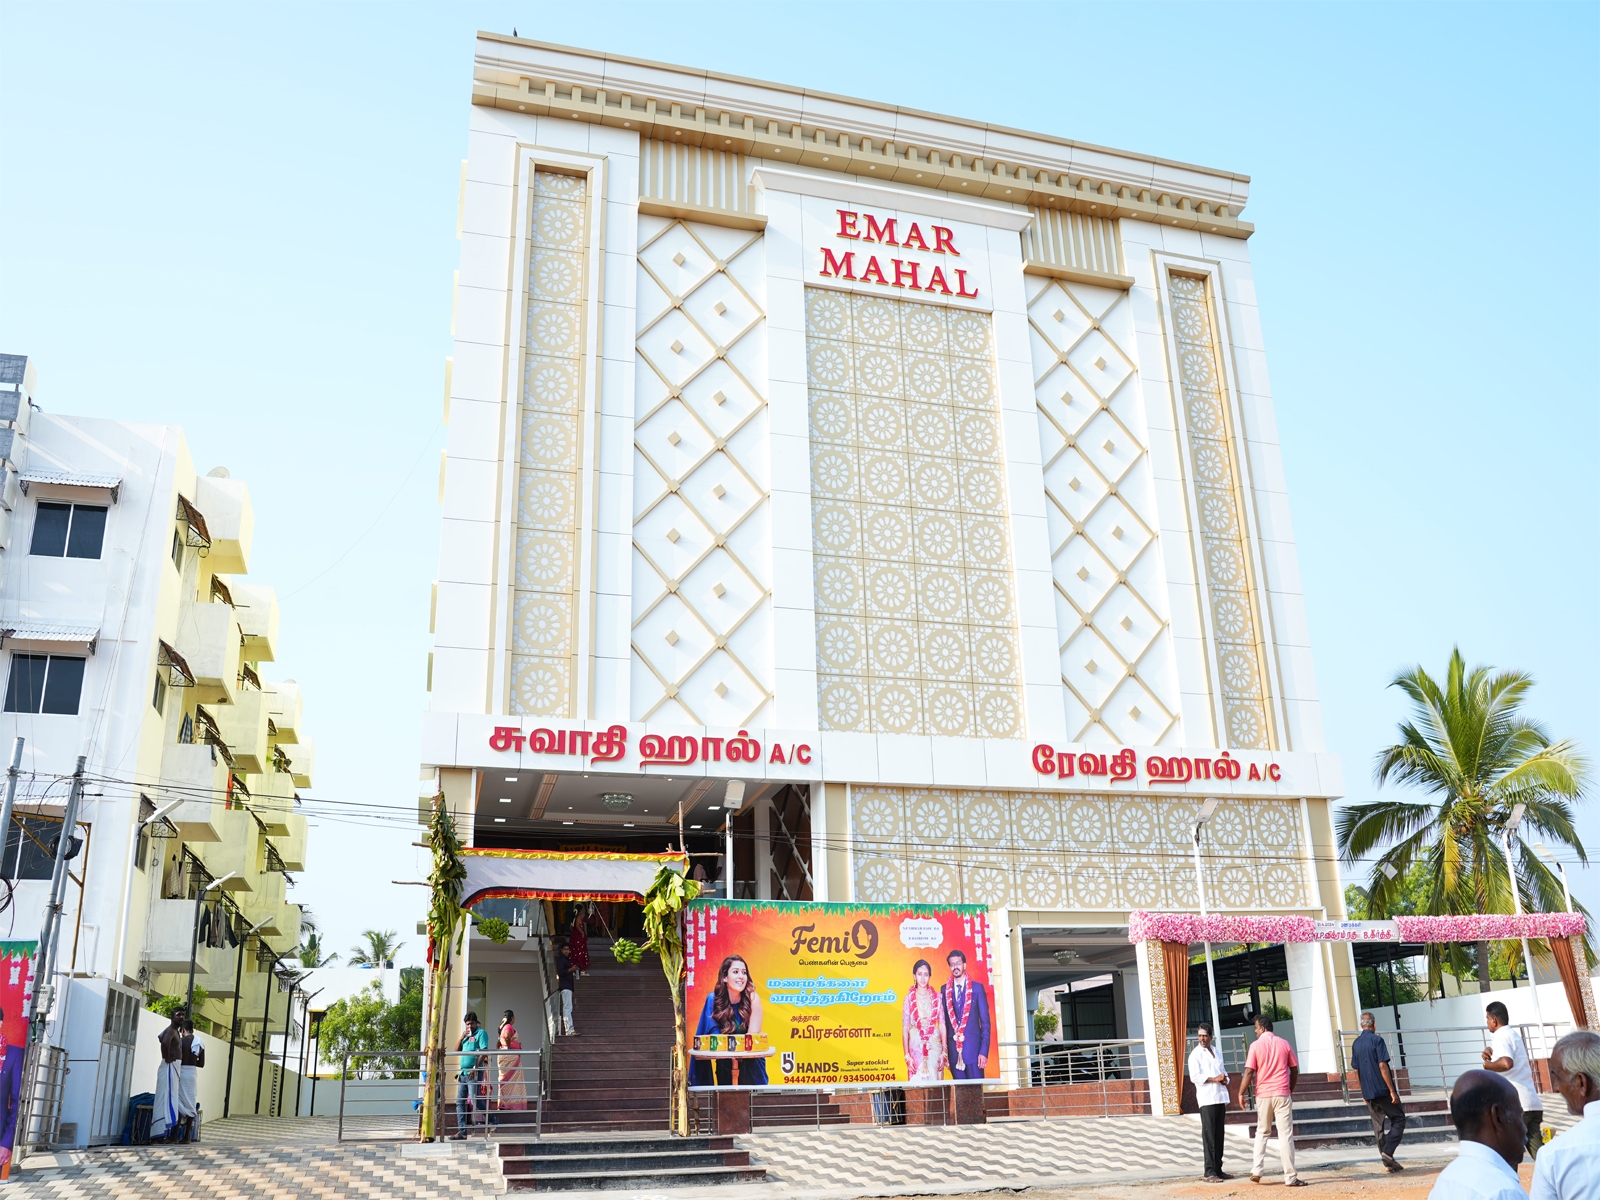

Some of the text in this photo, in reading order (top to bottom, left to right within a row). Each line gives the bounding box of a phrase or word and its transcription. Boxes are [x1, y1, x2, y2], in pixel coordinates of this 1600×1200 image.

[836, 209, 960, 256] EMAR
[819, 247, 978, 299] MAHAL
[489, 725, 812, 769] சுவாதி ஹால் A/C
[1032, 744, 1282, 787] ரேவதி ஹால் A/C
[839, 959, 868, 967] பெருமை
[767, 975, 868, 989] மணமக்களை
[770, 990, 897, 1006] வாழ்த்துகிறோம்
[790, 1025, 872, 1042] P.பிரசன்னா
[797, 1062, 839, 1073] HANDS
[784, 1075, 837, 1083] 9444744700
[843, 1073, 896, 1082] 9345004704
